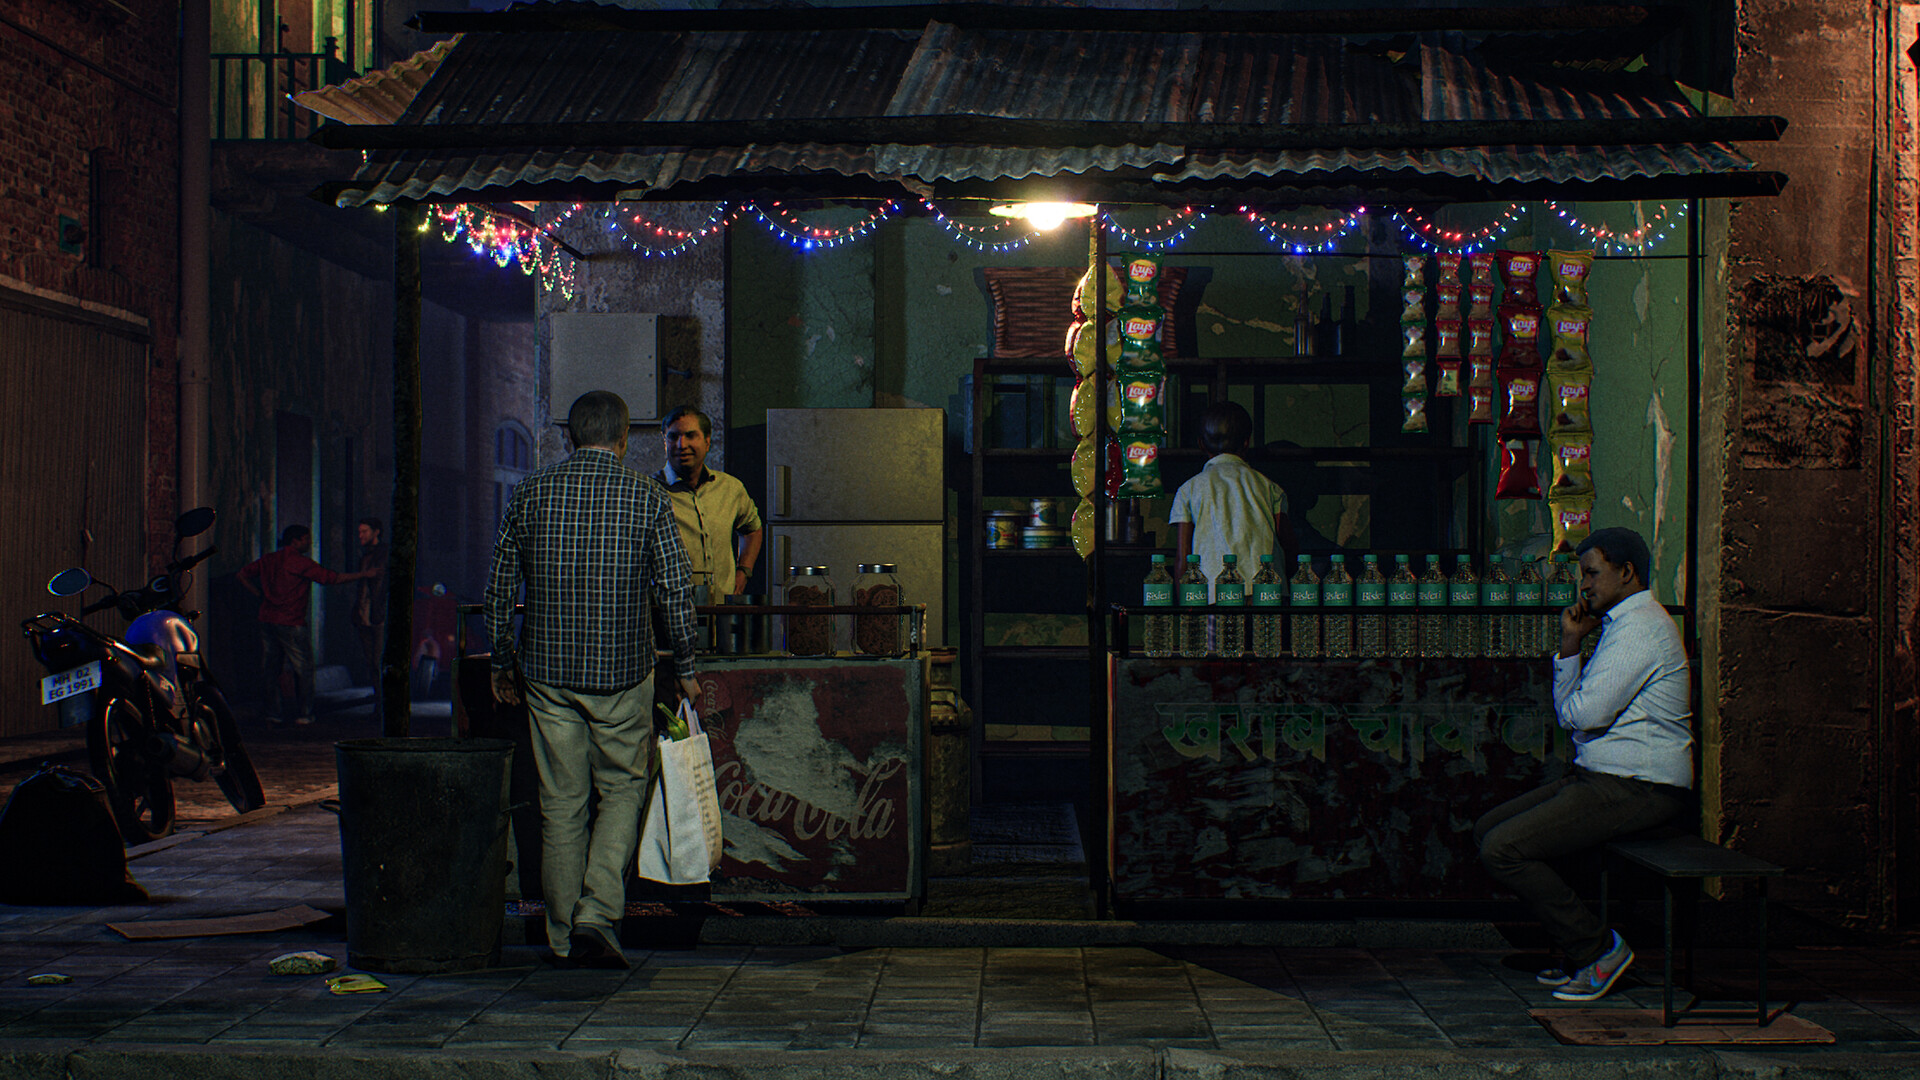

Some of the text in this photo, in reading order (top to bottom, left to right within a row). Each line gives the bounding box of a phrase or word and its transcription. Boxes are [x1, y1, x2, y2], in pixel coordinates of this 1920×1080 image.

[1217, 591, 1243, 602] Bisleri
[1260, 591, 1281, 602] Bisle
[52, 667, 91, 687] MH 02
[48, 677, 95, 700] EG 1991
[1153, 703, 1337, 763] खराब
